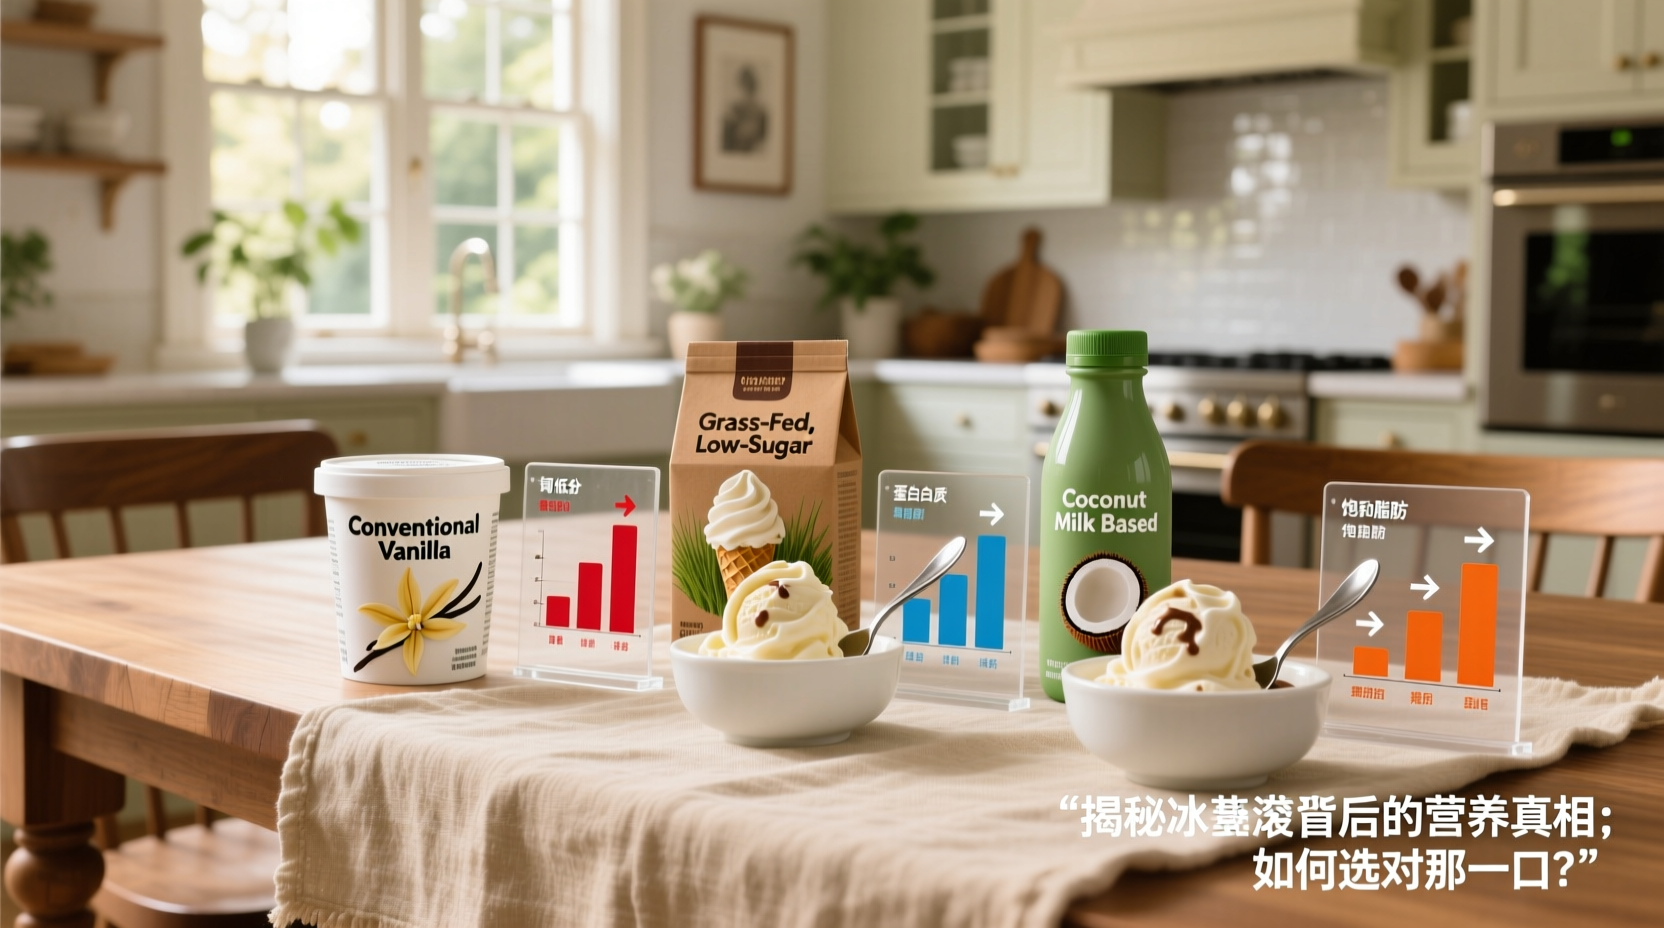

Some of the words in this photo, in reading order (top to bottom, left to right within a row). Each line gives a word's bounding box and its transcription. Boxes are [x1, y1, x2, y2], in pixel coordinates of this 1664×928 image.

[699, 412, 815, 435] Grass-Fed,
[696, 434, 813, 460] Low-Sugar
[1062, 488, 1147, 509] Coconut
[348, 512, 480, 537] Conventional
[1054, 511, 1096, 533] Milk
[1101, 512, 1158, 533] Based
[378, 540, 451, 561] Vanilla
